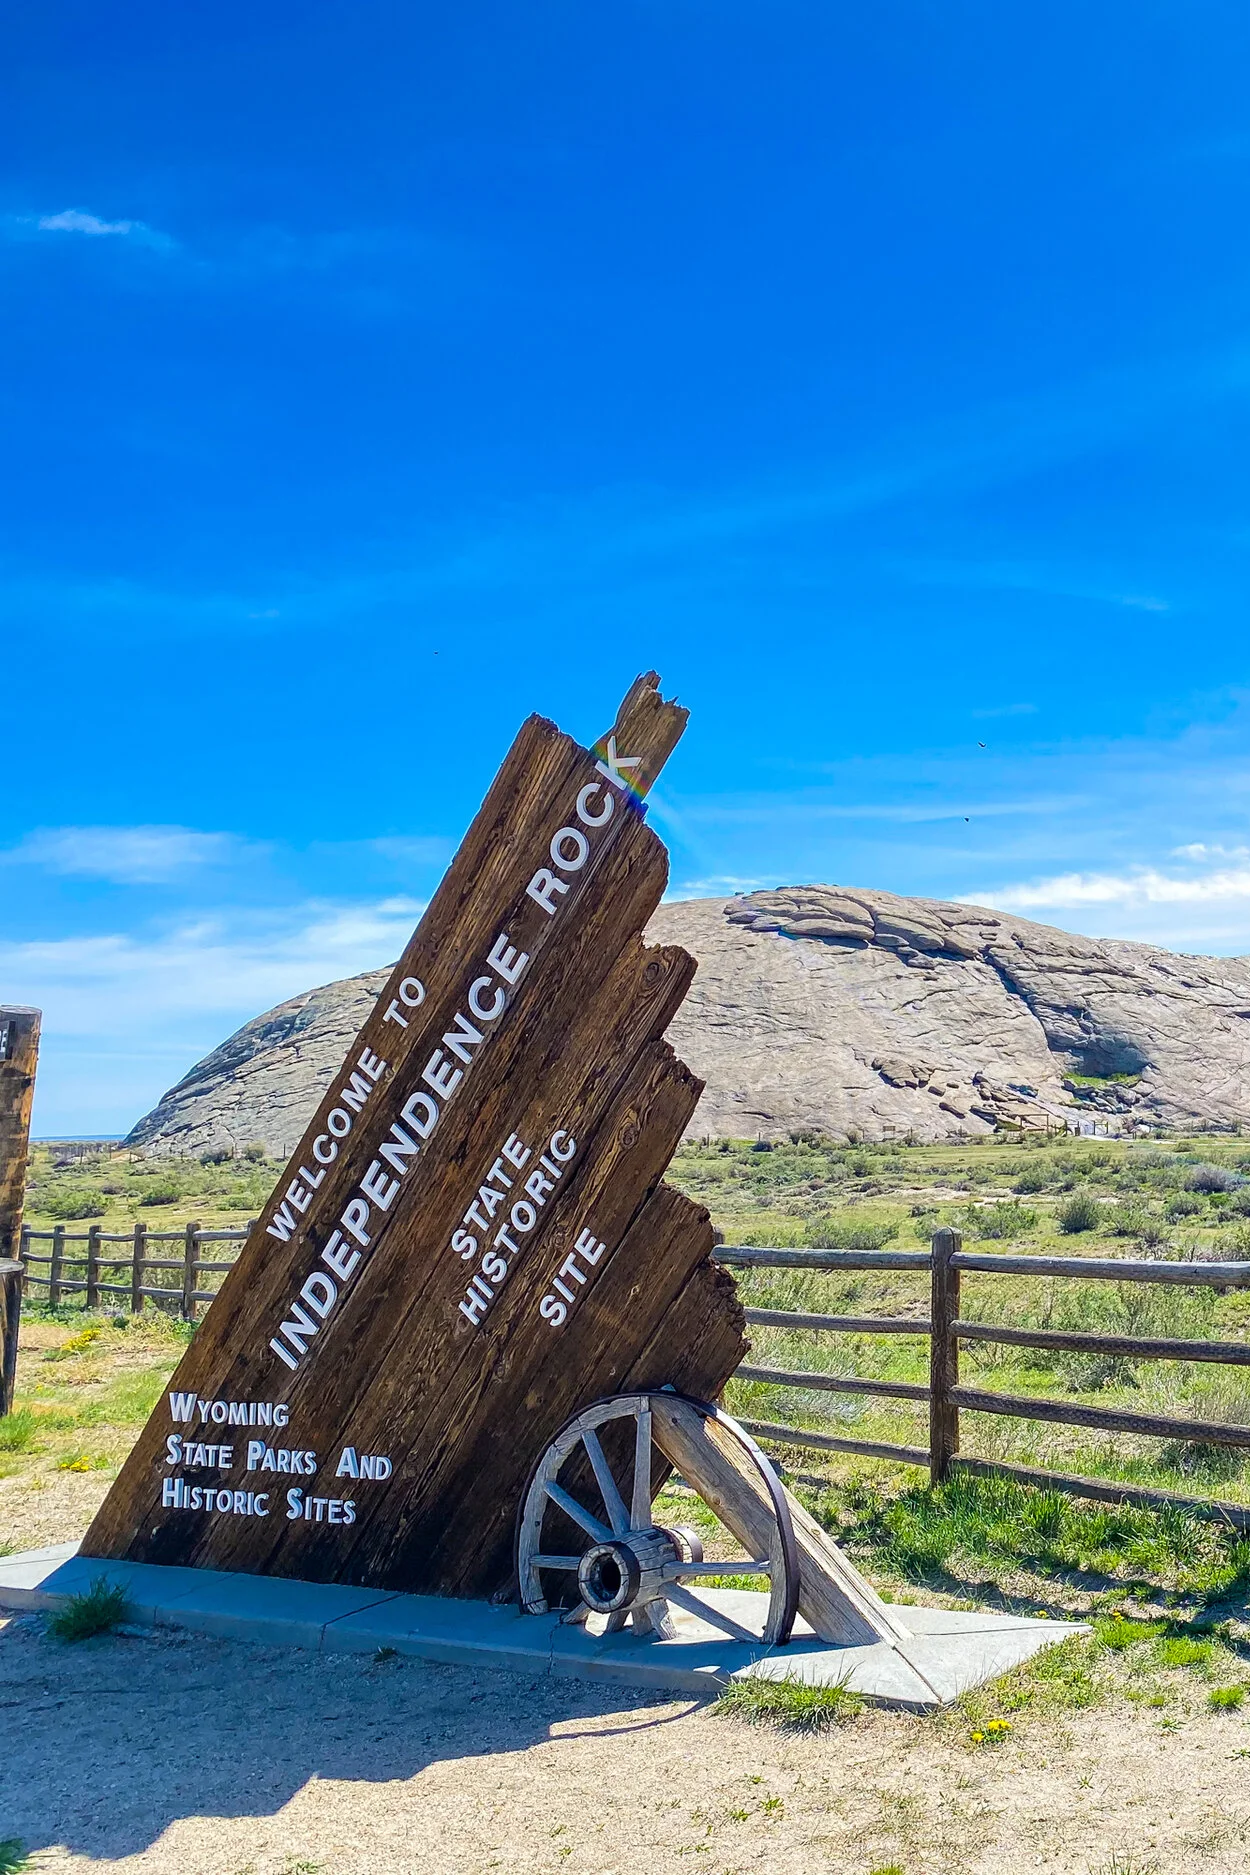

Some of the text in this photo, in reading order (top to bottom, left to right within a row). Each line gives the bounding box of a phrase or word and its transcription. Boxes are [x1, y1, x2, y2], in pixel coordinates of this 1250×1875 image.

[267, 976, 426, 1242] WELCOME TO
[270, 735, 642, 1370] INDEPENDENCE ROCK
[450, 1133, 533, 1262] STATE
[458, 1130, 578, 1325] HISTORIC
[538, 1227, 607, 1327] SITE
